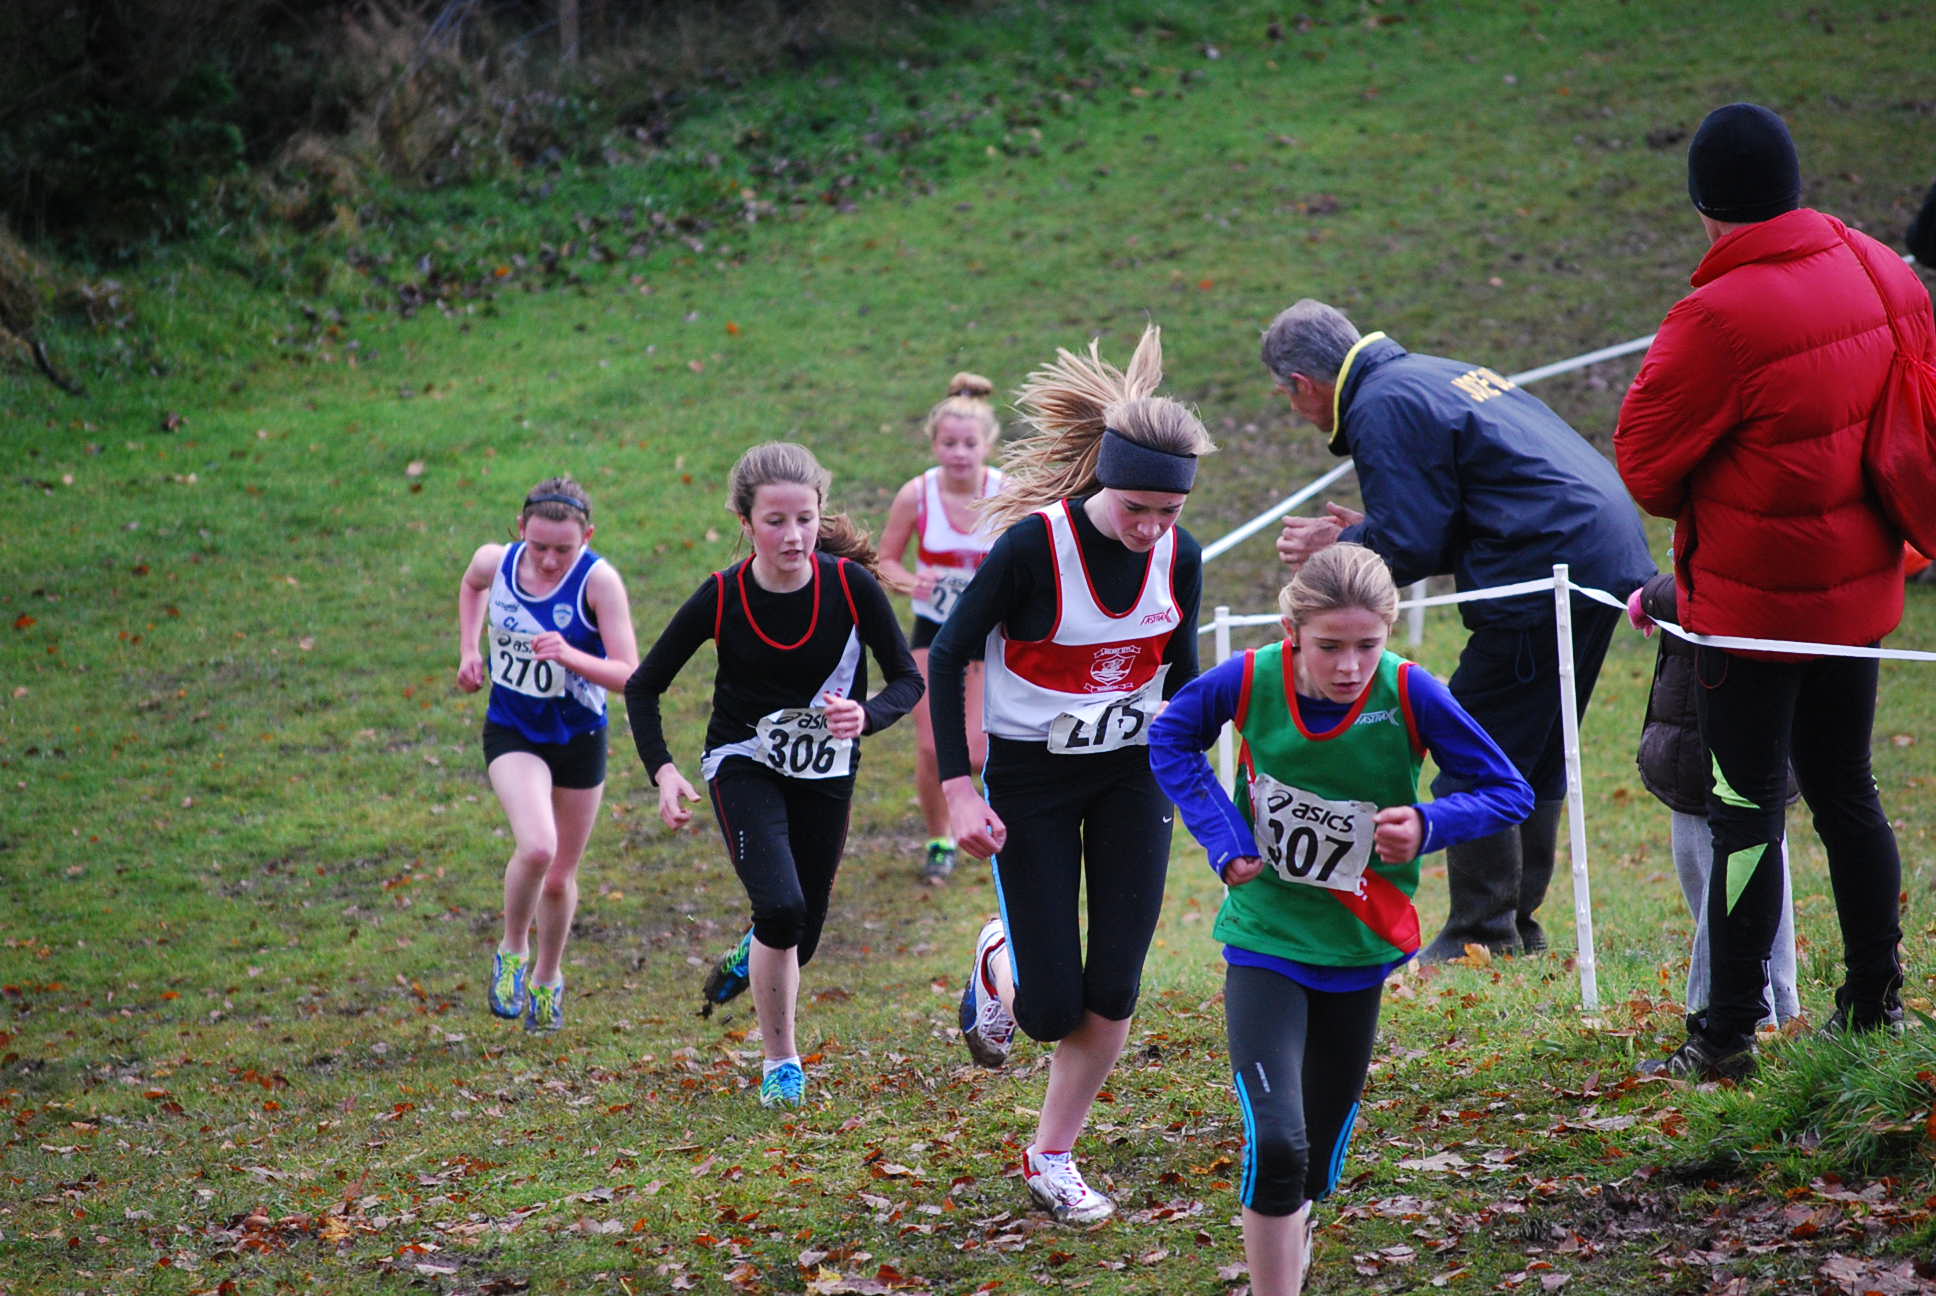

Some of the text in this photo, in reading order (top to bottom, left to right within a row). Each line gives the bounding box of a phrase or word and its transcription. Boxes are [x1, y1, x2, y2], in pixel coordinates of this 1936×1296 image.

[932, 586, 961, 615] 27
[499, 650, 553, 694] 270
[767, 728, 837, 774] 306
[1291, 802, 1355, 834] asics
